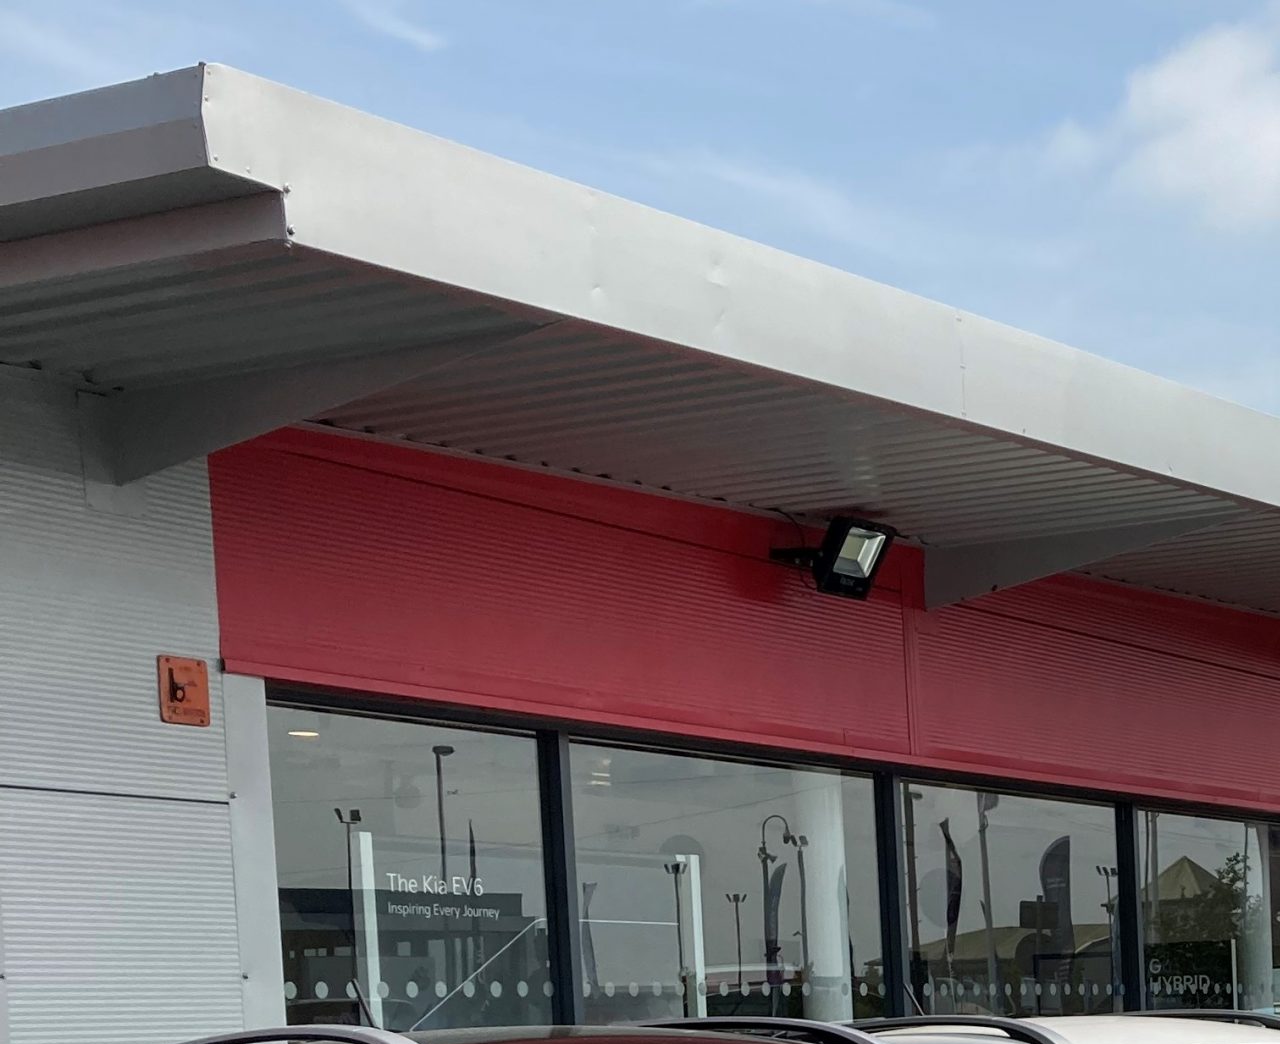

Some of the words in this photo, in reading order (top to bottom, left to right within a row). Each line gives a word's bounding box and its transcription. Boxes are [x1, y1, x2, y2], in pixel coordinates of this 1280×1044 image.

[386, 873, 418, 893] The
[422, 875, 448, 895] Kia
[452, 876, 484, 897] EV6
[387, 902, 431, 919] Inspiring
[433, 903, 461, 920] Every
[463, 905, 500, 920] Journey
[1149, 974, 1211, 991] HYBRID
